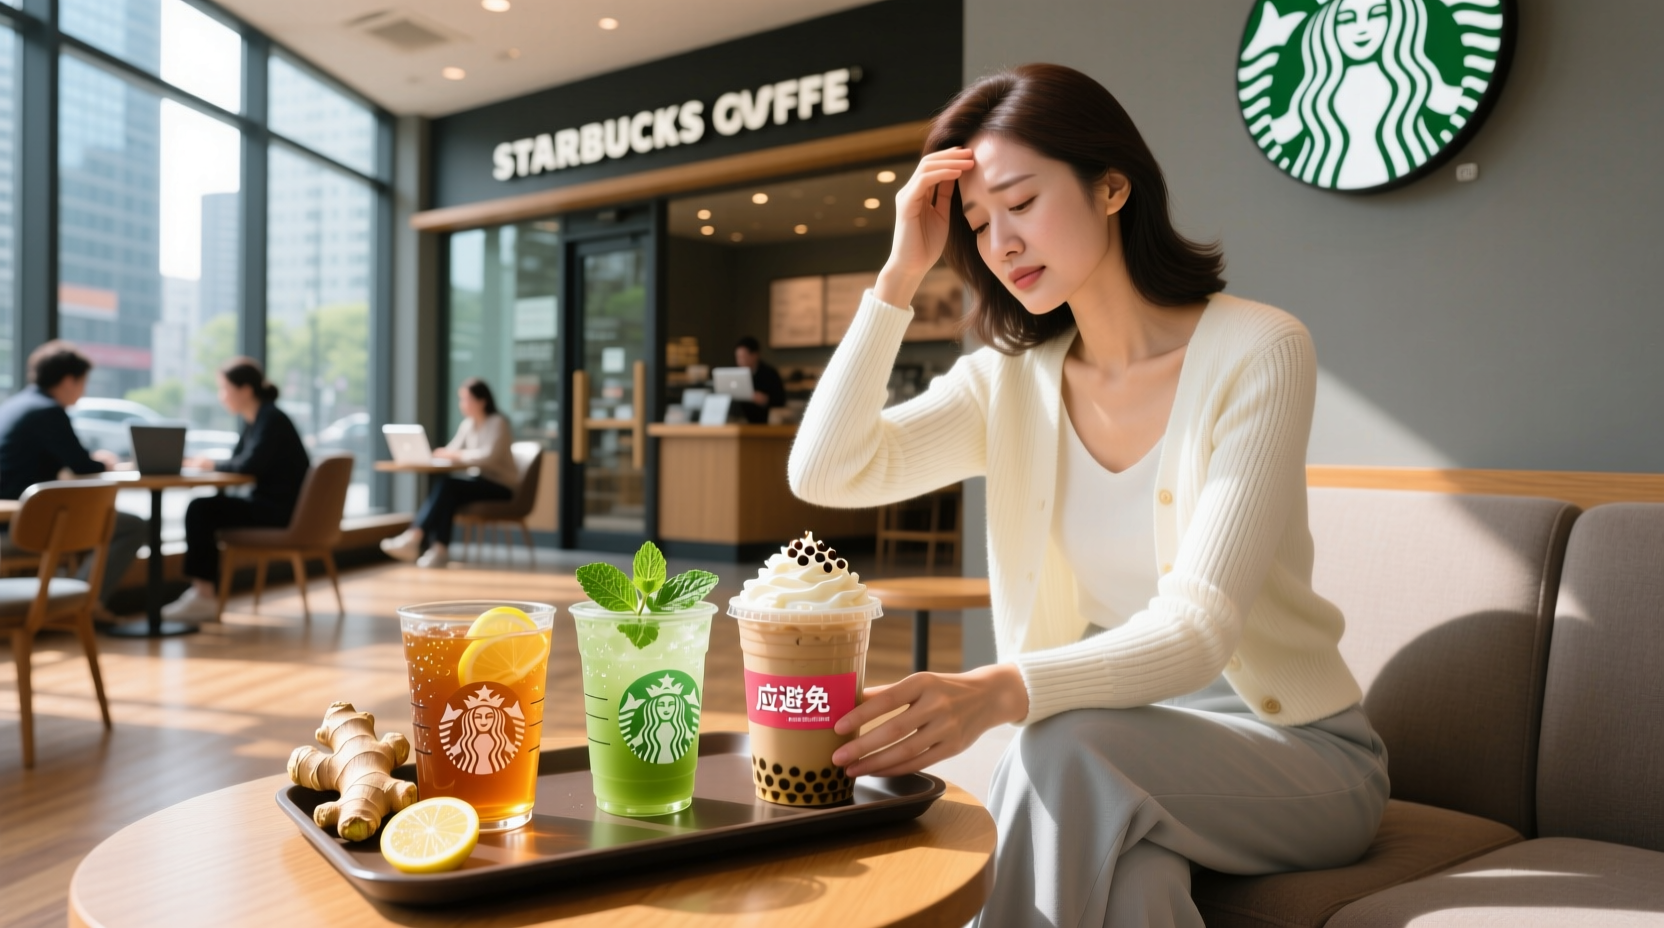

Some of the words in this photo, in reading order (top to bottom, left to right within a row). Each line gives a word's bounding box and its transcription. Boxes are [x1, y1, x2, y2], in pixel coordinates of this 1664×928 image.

[492, 100, 705, 182] STARBUCKS
[755, 683, 831, 714] 应避免
